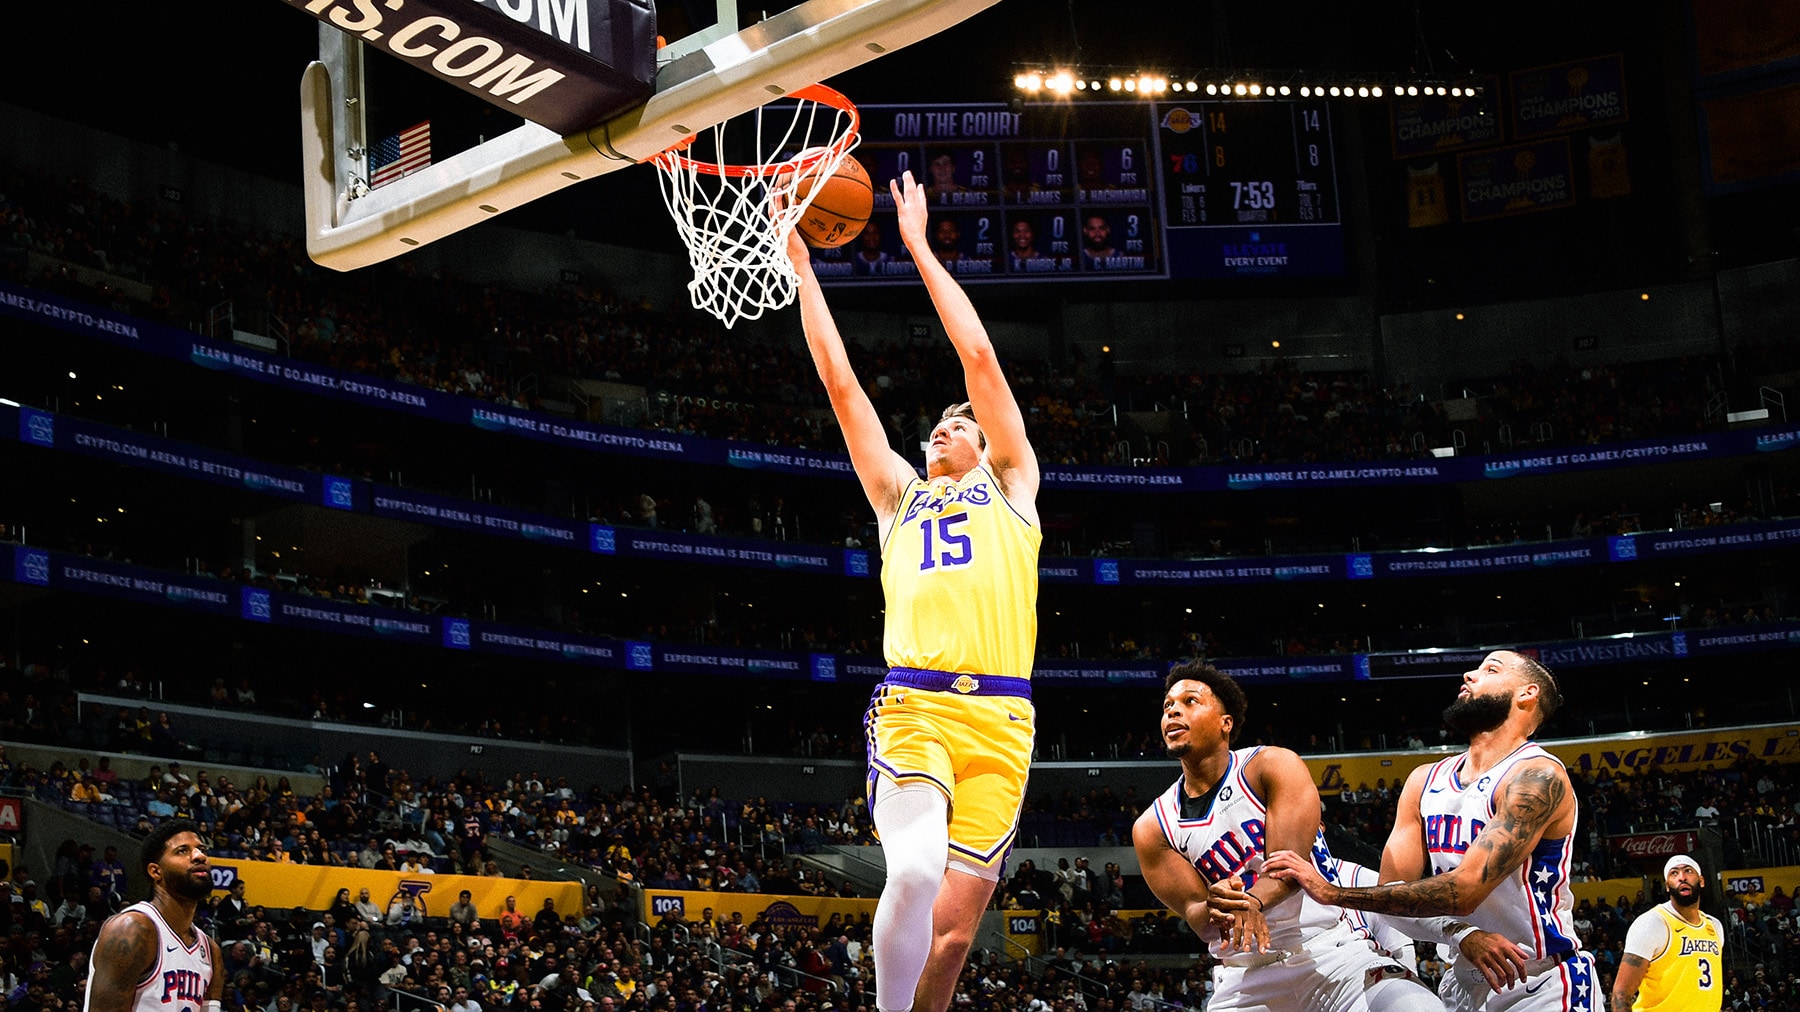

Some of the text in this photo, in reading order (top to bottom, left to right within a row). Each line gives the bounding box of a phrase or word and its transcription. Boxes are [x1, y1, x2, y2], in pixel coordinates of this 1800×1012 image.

[1519, 91, 1618, 121] CHAMPIONS
[894, 111, 1022, 138] ON THE COURT
[1208, 111, 1228, 134] 14
[1302, 109, 1320, 132] 14
[1400, 113, 1496, 141] CHAMPIONS
[972, 150, 985, 173] 3
[1047, 149, 1059, 172] 0
[1120, 148, 1133, 171] 6
[1308, 144, 1319, 167] 8
[972, 175, 988, 187] PTS
[1046, 174, 1063, 186] PTS
[1467, 174, 1566, 203] CHAMPIONS
[1230, 181, 1276, 210] 7:53
[977, 217, 990, 240] 2
[1052, 215, 1065, 239] 0
[1126, 214, 1139, 238] 3
[976, 242, 993, 255] PTS
[1051, 240, 1069, 253] PTS
[1125, 239, 1144, 252] PTS
[1105, 256, 1146, 270] MARTIN
[1224, 255, 1289, 267] EVERY EVENT
[191, 343, 230, 363] LEARN
[233, 354, 265, 373] MORE
[266, 363, 282, 377] AT
[472, 408, 506, 425] LEARN
[508, 415, 536, 432] MORE
[538, 421, 551, 434] AT
[1757, 431, 1789, 445] LEARN
[75, 432, 148, 459] CRYPTO.COM
[150, 448, 186, 468] ARENA
[188, 458, 200, 470] IS
[201, 460, 241, 480] BETTER
[729, 449, 762, 463] LEARN
[764, 453, 792, 467] MORE
[794, 457, 806, 469] AT
[1486, 460, 1521, 472] LEARN
[1523, 456, 1553, 469] MORE
[1555, 455, 1569, 465] AT
[1044, 472, 1057, 482] AT
[1228, 472, 1263, 483] LEARN
[1265, 471, 1294, 482] MORE
[1296, 471, 1310, 481] AT
[374, 496, 437, 517] CRYPTO.COM
[439, 507, 471, 523] ARENA
[472, 513, 482, 525] IS
[484, 515, 518, 531] BETTER
[900, 483, 992, 527] LAKERS
[632, 540, 694, 554] CRYPTO.COM
[695, 545, 727, 558] ARENA
[728, 549, 737, 559] IS
[739, 549, 773, 562] BETTER
[919, 512, 973, 572] 15
[1654, 538, 1717, 551] CRYPTO.COM
[1719, 533, 1752, 545] ARENA
[1753, 533, 1764, 543] IS
[1135, 568, 1191, 579] CRYPTO.COM
[1192, 568, 1223, 578] ARENA
[1224, 568, 1236, 578] IS
[1237, 567, 1272, 577] BETTER
[1389, 560, 1447, 572] CRYPTO.COM
[1449, 559, 1481, 569] ARENA
[1482, 557, 1492, 567] IS
[1494, 554, 1530, 566] BETTER
[64, 567, 131, 589] EXPERIENCE
[133, 577, 165, 594] MORE
[282, 603, 342, 624] EXPERIENCE
[343, 612, 371, 627] MORE
[481, 631, 536, 649] EXPERIENCE
[537, 639, 561, 652] MORE
[1699, 633, 1757, 647] EXPERIENCE
[1758, 630, 1787, 642] MORE
[664, 652, 719, 667] EXPERIENCE
[720, 655, 745, 668] MORE
[1260, 665, 1287, 676] MORE
[1032, 669, 1079, 679] XPERIENCE
[1081, 669, 1105, 679] MORE
[1572, 740, 1751, 771] ANGELES
[1193, 818, 1266, 886] HILA
[211, 868, 236, 887] 02
[655, 898, 682, 912] 103
[1011, 917, 1037, 934] 104
[1678, 936, 1720, 956] LAKERS
[1698, 958, 1713, 989] 3
[160, 968, 208, 1008] PHIL
